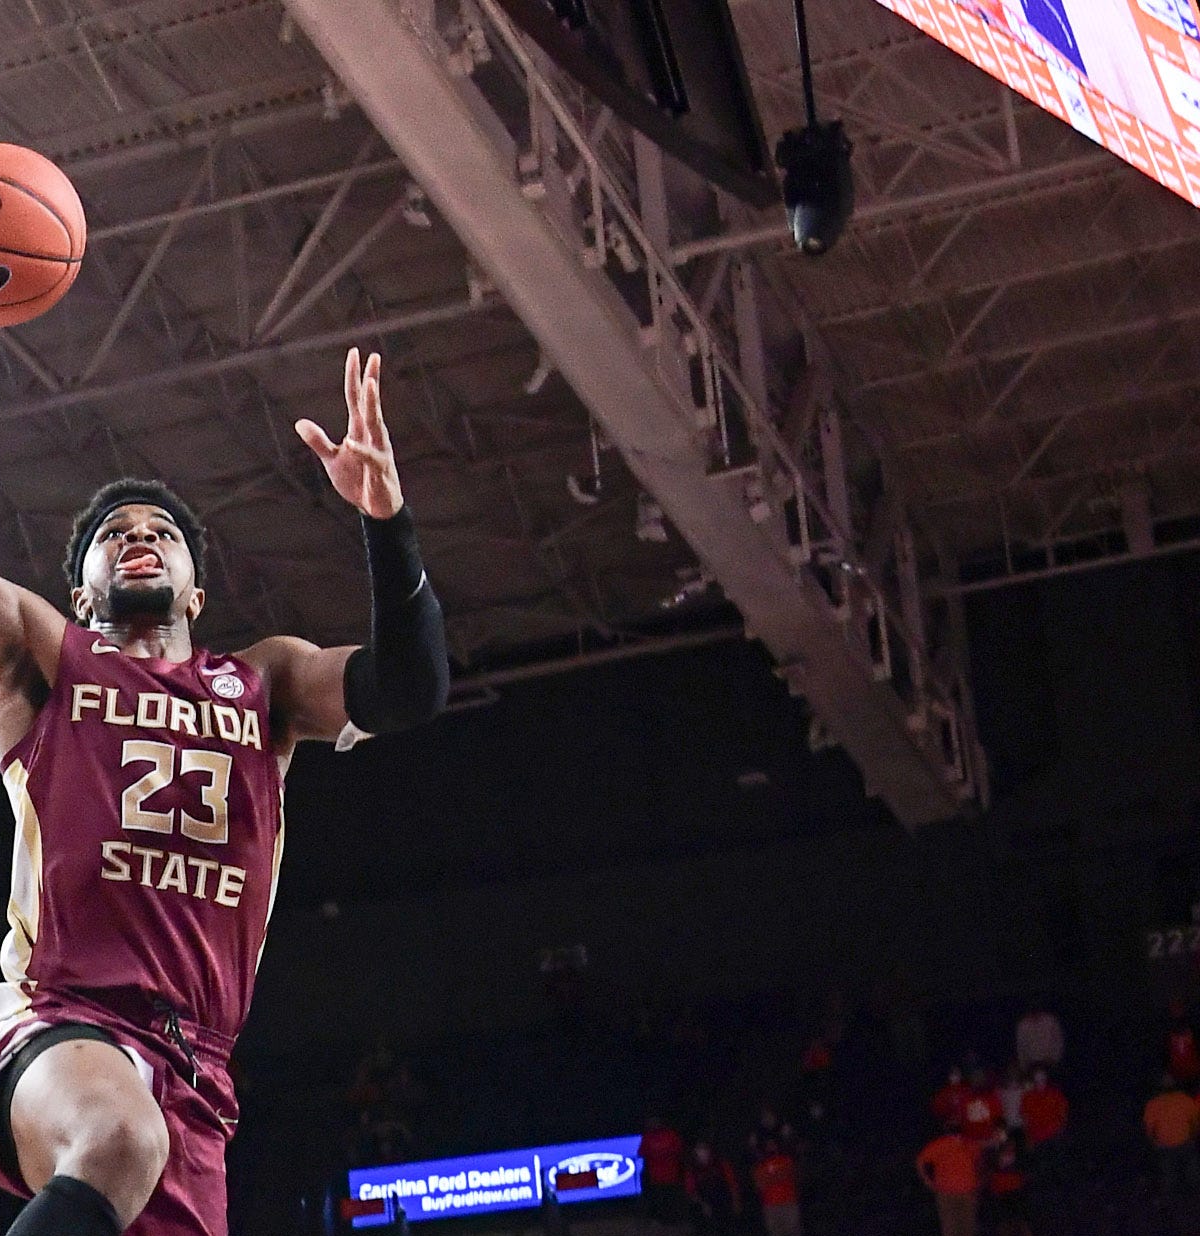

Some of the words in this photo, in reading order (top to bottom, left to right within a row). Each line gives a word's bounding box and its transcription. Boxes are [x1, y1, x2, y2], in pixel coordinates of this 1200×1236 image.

[71, 683, 262, 750] FLORIDA
[120, 739, 233, 844] 23
[101, 840, 246, 908] STATE
